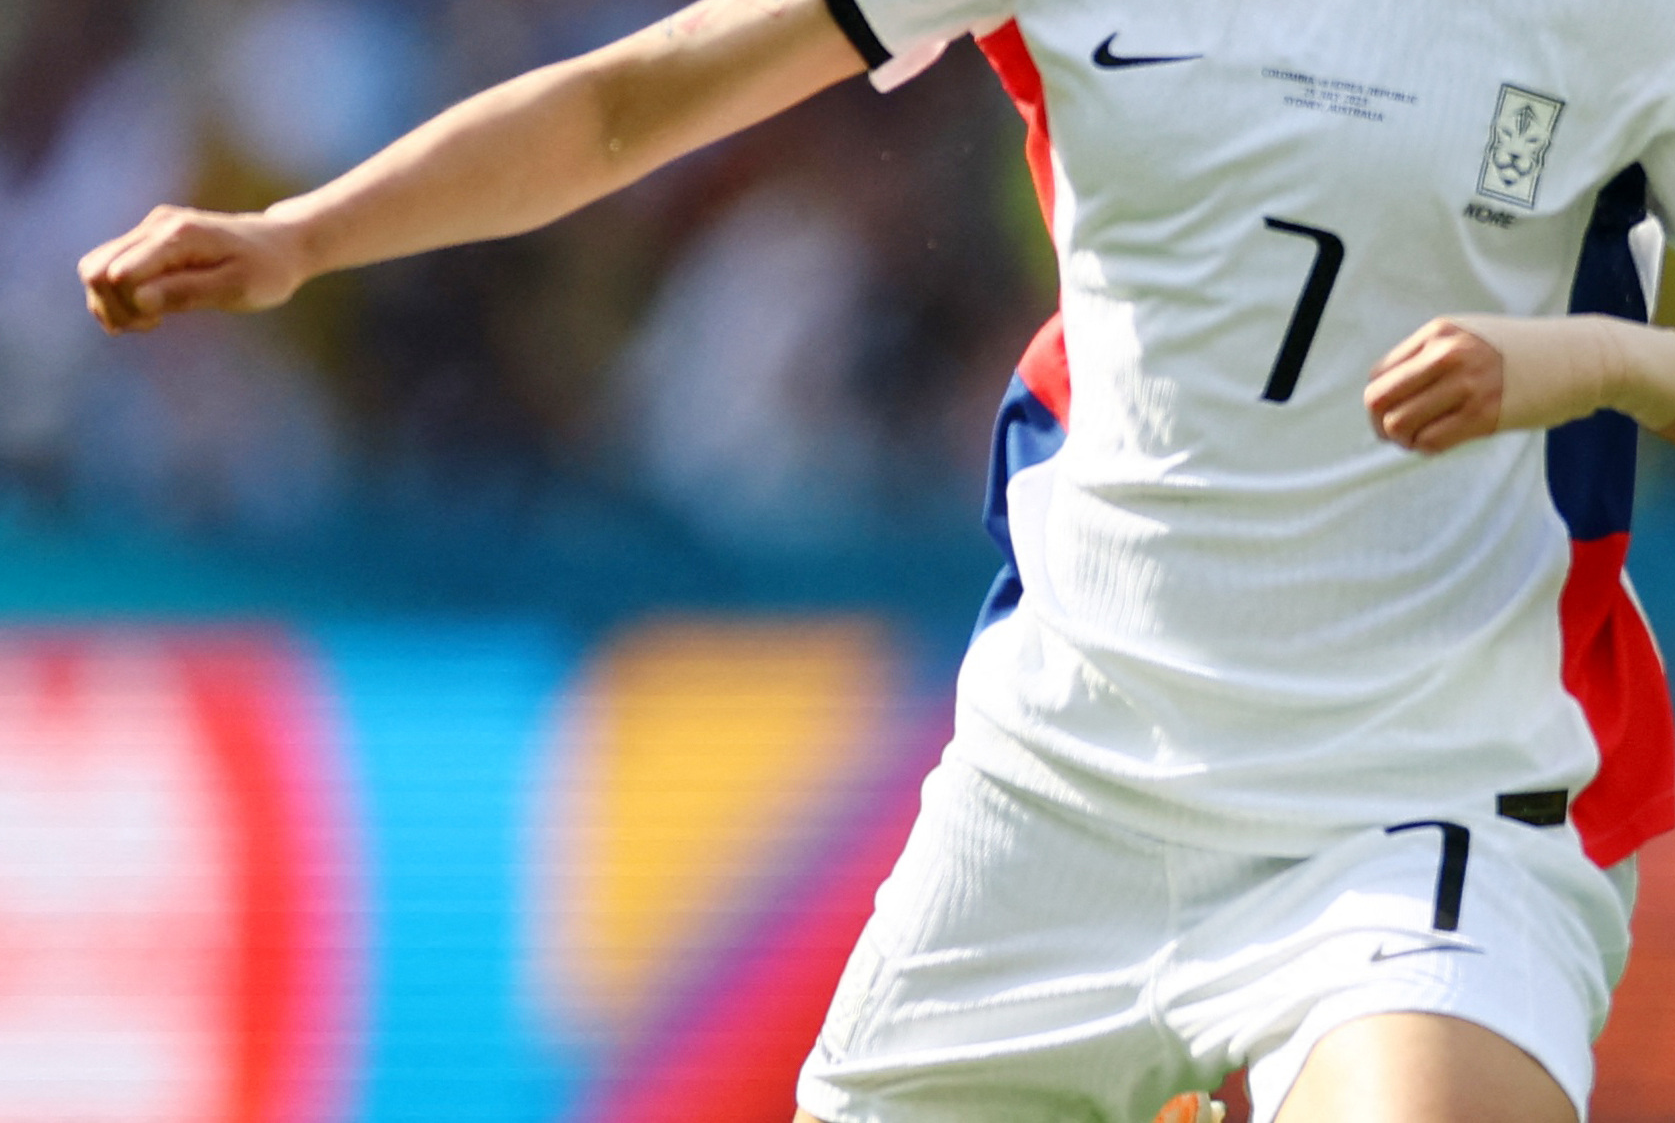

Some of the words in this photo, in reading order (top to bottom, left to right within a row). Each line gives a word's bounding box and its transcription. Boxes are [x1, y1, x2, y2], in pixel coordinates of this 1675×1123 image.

[1261, 67, 1314, 85] COLOMBIA
[1331, 80, 1363, 96] KOREA
[1367, 85, 1418, 104] REPUBLIC
[1327, 103, 1384, 122] AUSTRALIA
[1261, 215, 1345, 403] 7
[1384, 819, 1471, 933] 7
